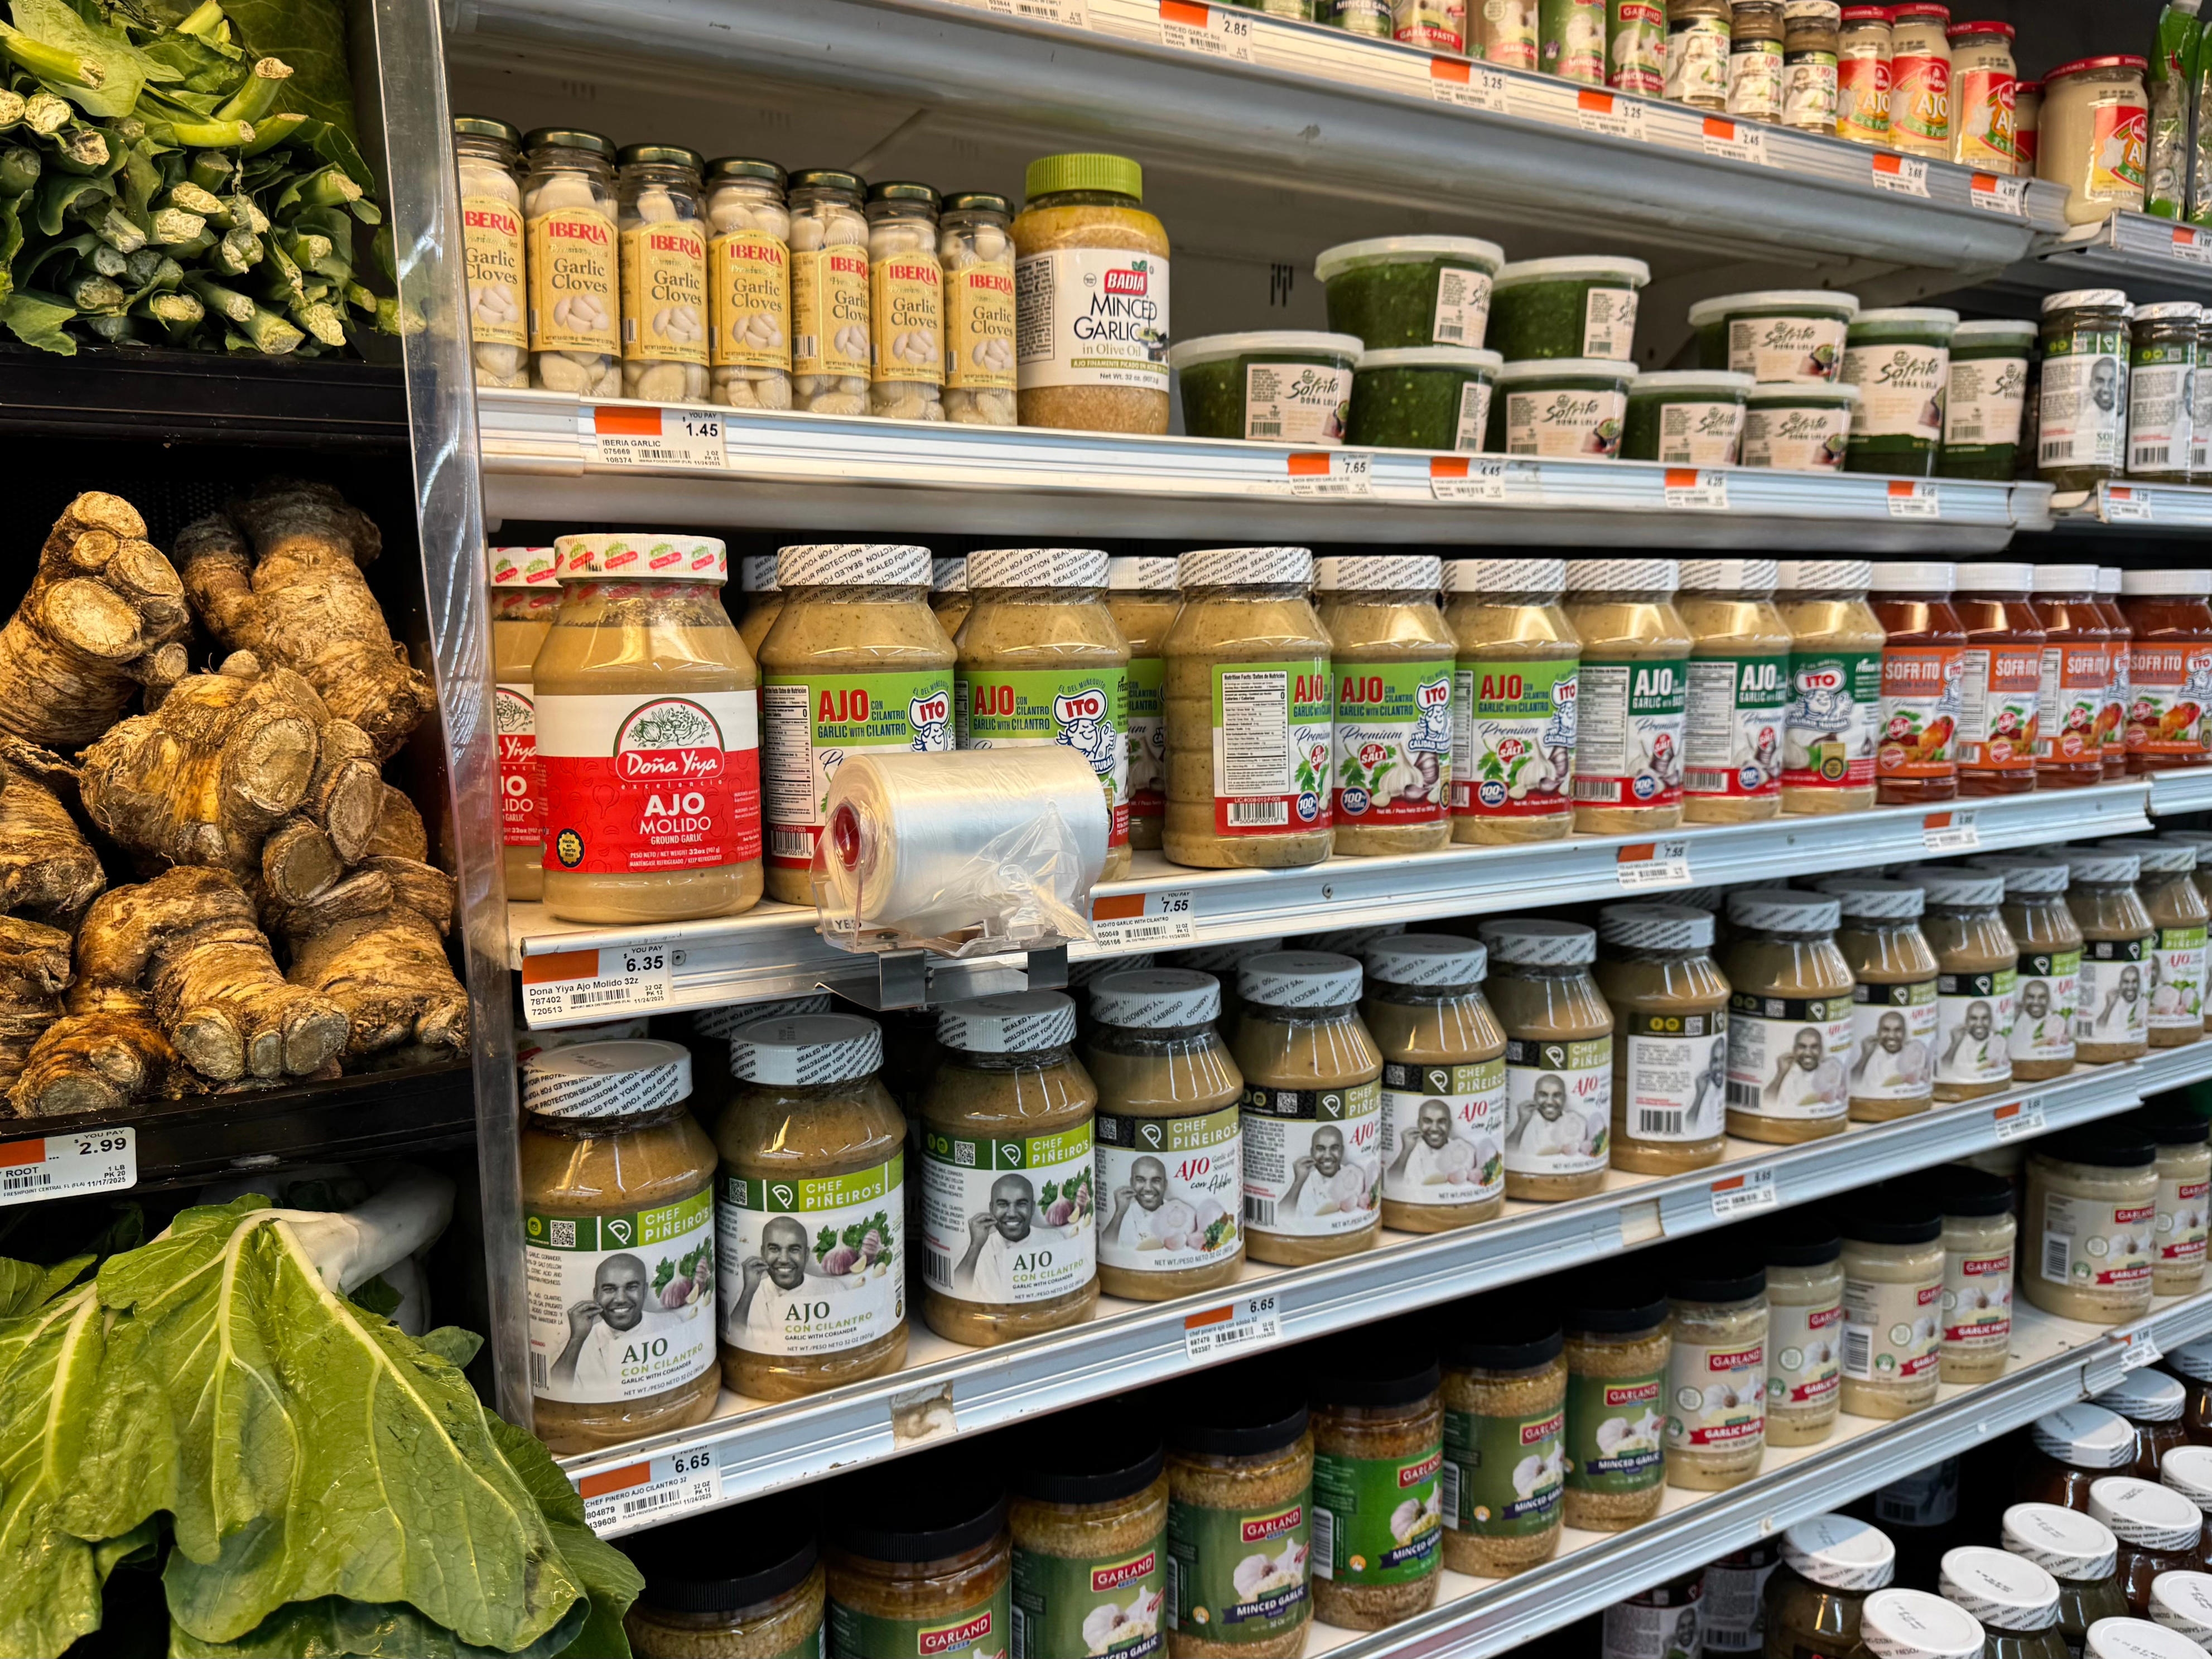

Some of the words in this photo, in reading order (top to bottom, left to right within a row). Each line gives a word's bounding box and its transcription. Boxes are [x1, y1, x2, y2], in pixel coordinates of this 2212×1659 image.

[1164, 23, 1187, 33] MINCED
[1188, 28, 1208, 38] GARLIC
[1224, 20, 1247, 36] 2.85
[1400, 28, 1432, 38] GARLIC
[1433, 30, 1455, 42] PASTE
[1483, 77, 1502, 89] 3.25
[1916, 94, 1948, 118] AJO
[549, 222, 608, 246] IBERIA
[650, 235, 702, 260] IBERIA
[730, 244, 782, 267] IBERIA
[554, 258, 605, 277] Garlic
[890, 266, 937, 286] IBERIA
[552, 274, 608, 293] Cloves
[654, 270, 700, 290] Garlic
[734, 278, 779, 297] Garlic
[970, 274, 1013, 296] IBERIA
[1107, 271, 1144, 291] BADIA
[652, 286, 702, 306] Cloves
[732, 293, 782, 311] Cloves
[893, 297, 936, 315] Garlic
[973, 307, 1011, 323] Garlic
[1091, 291, 1157, 321] MINCED
[891, 312, 937, 329] Cloves
[971, 320, 1013, 337] Cloves
[1074, 316, 1140, 341] GARLIC
[1083, 343, 1093, 354] in
[1096, 344, 1124, 355] Olive
[1127, 346, 1141, 356] Oil
[686, 423, 717, 437] 1.45
[1344, 462, 1366, 473] 7.65
[816, 548, 862, 576] PROTECTION
[1634, 668, 1673, 697] AJO
[1740, 664, 1776, 691] AJO
[1805, 674, 1835, 687] ITO
[1294, 674, 1323, 704] AJO
[1340, 677, 1384, 703] AJO
[1426, 687, 1446, 703] ITO
[1480, 675, 1522, 701] AJO
[1560, 686, 1575, 699] ITO
[1739, 691, 1765, 703] GARLIC
[818, 689, 869, 722] AJO
[871, 701, 883, 710] CON
[974, 686, 1014, 716] AJO
[1016, 696, 1028, 705] CON
[1066, 698, 1099, 717] ITO
[1385, 694, 1413, 703] CILANTRO
[1519, 702, 1548, 712] CILANTRO
[1632, 697, 1660, 708] GARLIC
[872, 710, 905, 721] CILANTRO
[919, 701, 944, 718] ITO
[1016, 705, 1049, 716] CILANTRO
[1339, 706, 1365, 716] GARLIC
[1380, 705, 1414, 716] CILANTRO
[818, 725, 847, 739] GARLIC
[849, 726, 865, 737] WITH
[866, 724, 906, 736] CILANTRO
[973, 717, 996, 730] GARLIC
[997, 721, 1010, 730] WITH
[1011, 718, 1050, 730] CILANTRO
[1478, 721, 1539, 737] Premium
[1361, 753, 1385, 762] SALT
[1500, 747, 1521, 756] SALT
[627, 753, 678, 775] Doña
[681, 750, 717, 777] Yiya
[644, 792, 705, 817] AJO
[639, 816, 711, 835] MOLIDO
[651, 835, 679, 845] GROUND
[681, 833, 702, 843] GARLIC
[1163, 900, 1188, 913] 7.55
[627, 955, 663, 972] 6.35
[577, 983, 590, 992] Ajo
[594, 979, 622, 988] Molido
[531, 996, 561, 1006] 787402
[532, 1006, 562, 1015] 720513
[1458, 1066, 1485, 1078] CHEF
[1572, 1076, 1598, 1097] AJO
[540, 1091, 579, 1109] PROTECTION
[604, 1097, 619, 1108] FOR
[1458, 1099, 1487, 1123] AJO
[1173, 1119, 1207, 1134] CHEF
[79, 1137, 126, 1155] 2.99
[1032, 1137, 1062, 1151] CHEF
[1173, 1125, 1238, 1149] PIÑEIRO'S
[6, 1167, 38, 1178] ROOT
[1174, 1156, 1210, 1181] AJO
[4, 1188, 37, 1197] FRESHPOINT
[87, 1176, 126, 1187] 11/17/2025
[806, 1180, 842, 1193] CHEF
[807, 1183, 881, 1208] PIÑEIRO'S
[645, 1207, 679, 1225] CHEF
[1013, 1251, 1052, 1272] AJO
[1013, 1274, 1036, 1282] CON
[1040, 1259, 1083, 1279] CILANTRO
[785, 1301, 830, 1323] AJO
[1250, 1298, 1274, 1313] 6.65
[785, 1325, 811, 1333] CON
[816, 1311, 873, 1331] CILANTRO
[825, 1327, 857, 1337] CORIANDER
[621, 1338, 668, 1364] AJO
[621, 1364, 649, 1377] CON
[654, 1342, 703, 1370] CILANTRO
[1713, 1349, 1762, 1367] GARLAND
[621, 1376, 644, 1385] GARLIC
[663, 1360, 692, 1376] CORIANDER
[1610, 1384, 1657, 1402] GARLAND
[1705, 1427, 1739, 1439] GARLIC
[676, 1453, 710, 1473] 6.65
[1598, 1457, 1633, 1470] MINCED
[586, 1499, 603, 1508] CHEF
[605, 1492, 629, 1503] PINERO
[646, 1479, 678, 1492] CILANTRO
[1515, 1494, 1546, 1511] MINCED
[1247, 1511, 1298, 1537] GARLAND
[1392, 1539, 1427, 1560] MINCED
[1097, 1556, 1152, 1585] GARLAND
[1236, 1598, 1276, 1617] MINCED
[1279, 1586, 1303, 1607] GARLIC
[926, 1618, 988, 1648] GARLAND
